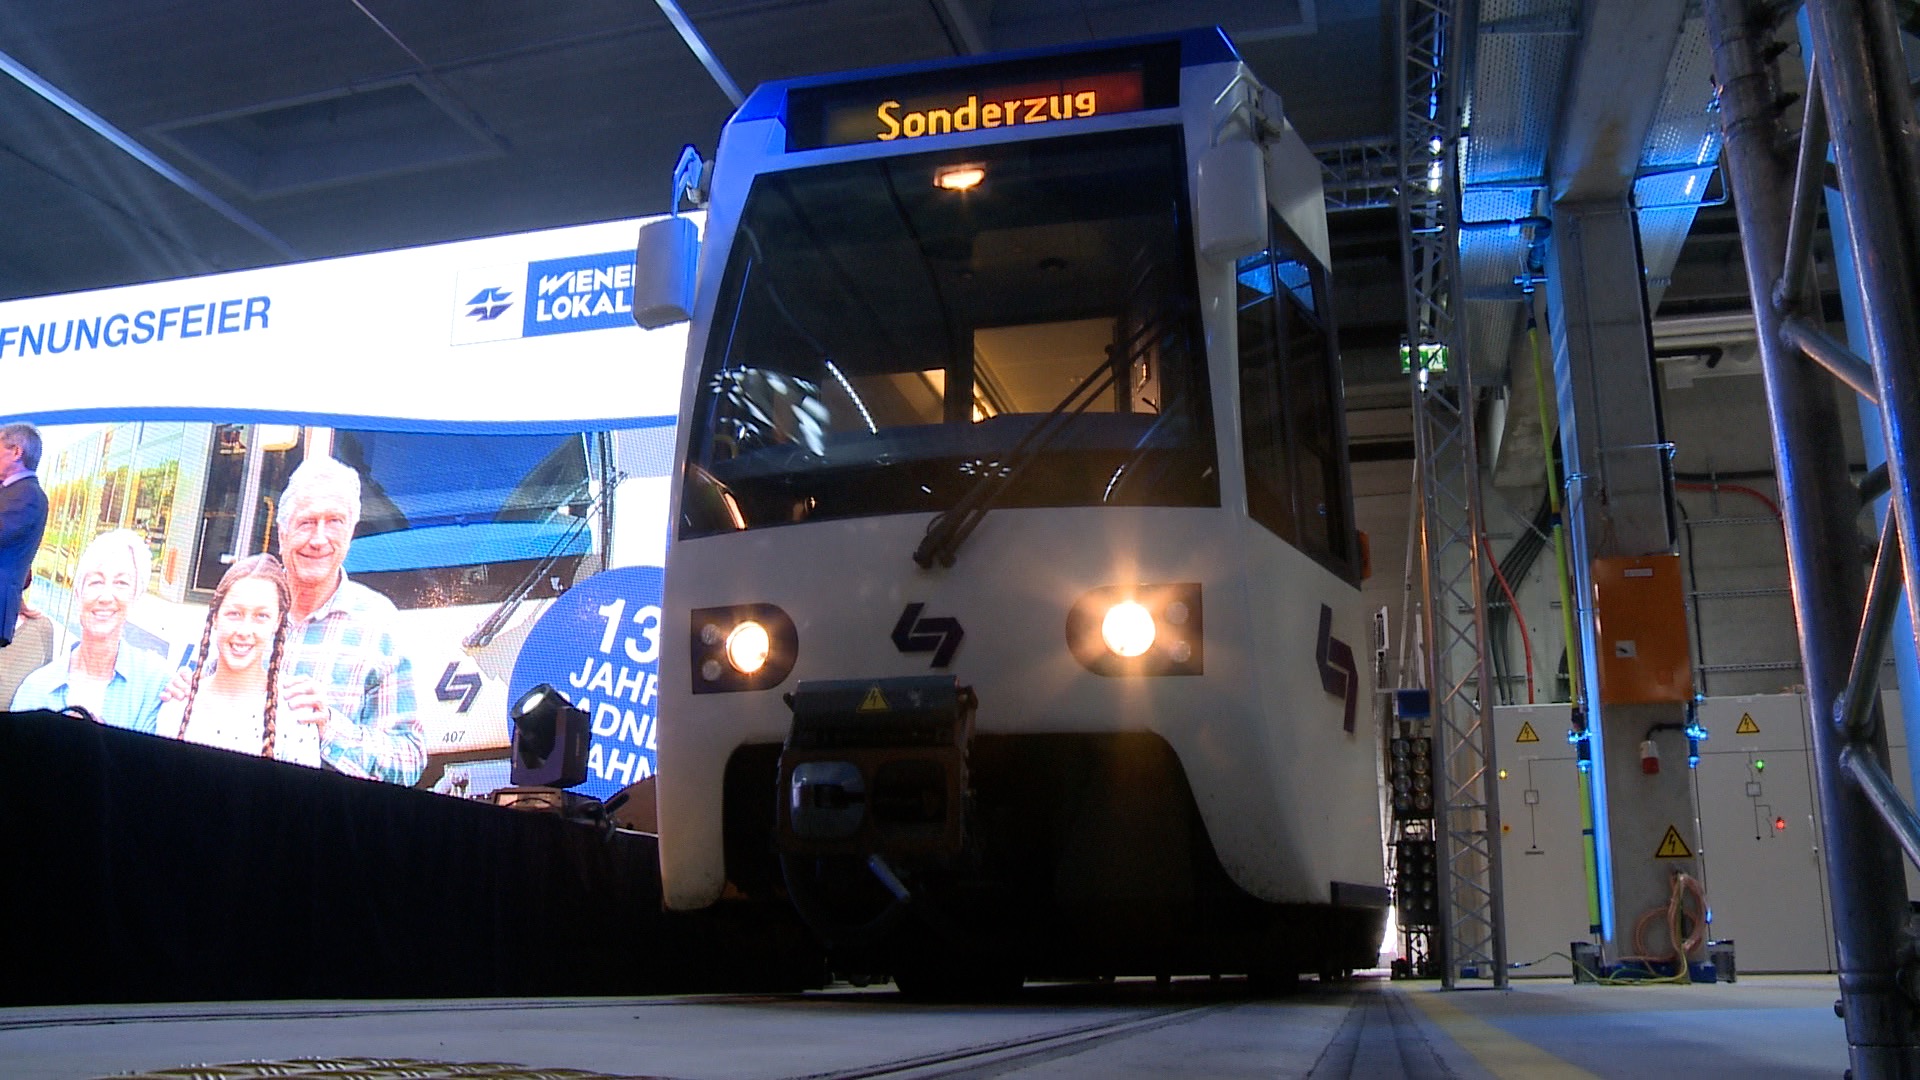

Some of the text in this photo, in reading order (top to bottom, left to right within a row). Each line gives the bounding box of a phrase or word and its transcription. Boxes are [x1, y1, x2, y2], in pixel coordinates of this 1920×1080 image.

[877, 90, 1096, 141] Sonderzug
[536, 290, 631, 322] LOKAL
[442, 730, 465, 743] 407
